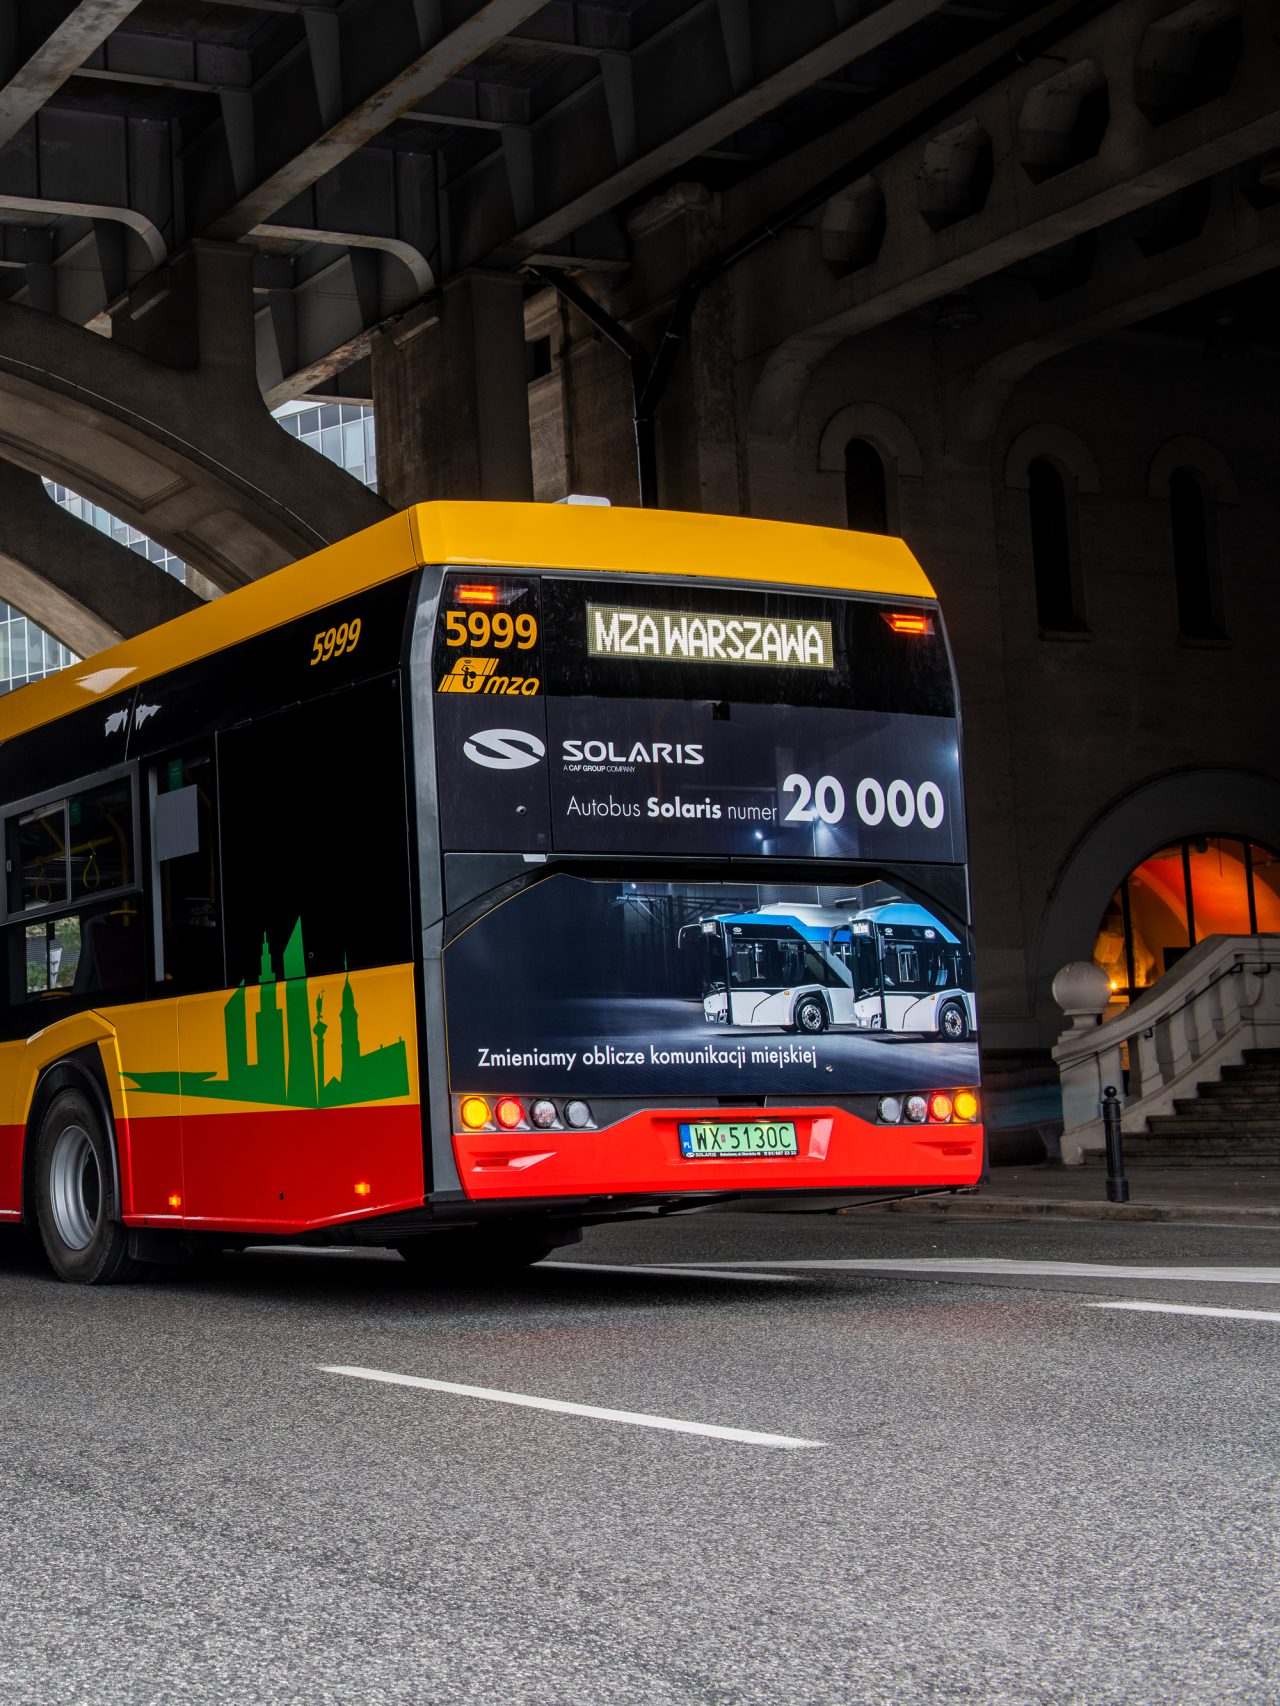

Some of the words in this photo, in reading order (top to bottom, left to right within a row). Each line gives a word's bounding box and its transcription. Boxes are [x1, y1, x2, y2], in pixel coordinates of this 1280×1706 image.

[310, 617, 362, 666] 5999
[446, 610, 538, 650] 5999
[595, 612, 660, 654] MZA
[664, 616, 825, 665] WARSZAWA
[483, 676, 540, 696] mza
[562, 740, 705, 765] SOLARIS
[569, 764, 581, 772] CAF
[582, 765, 606, 773] GROUP
[606, 765, 636, 773] COMPANY
[567, 795, 641, 817] Autobus
[647, 796, 722, 819] Solaris
[727, 805, 778, 821] numer
[782, 773, 846, 825] 20
[855, 777, 945, 830] 000
[477, 1047, 577, 1071] Zmieniamy
[582, 1045, 646, 1065] oblicze
[650, 1044, 746, 1069] komunikacji
[751, 1044, 817, 1069] miejskiej
[683, 1141, 692, 1149] PL
[694, 1127, 722, 1150] WX
[729, 1126, 792, 1149] 5130C
